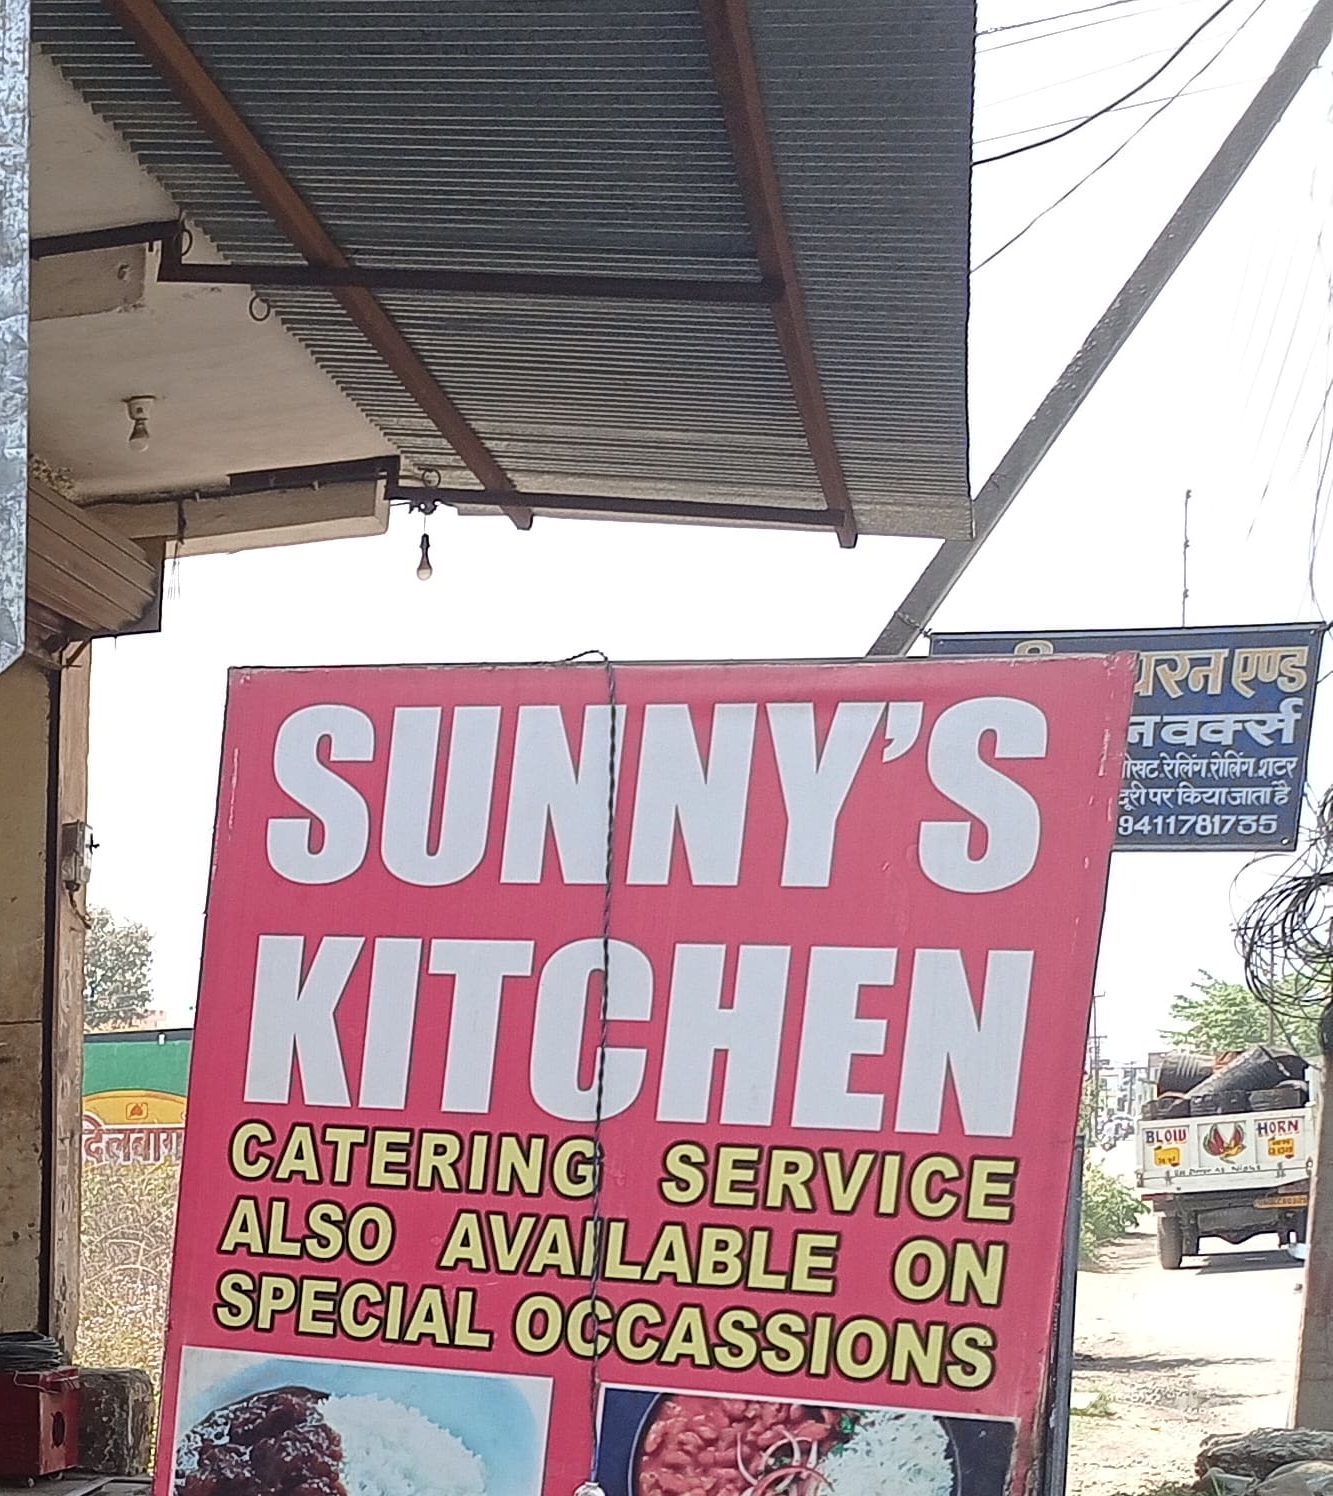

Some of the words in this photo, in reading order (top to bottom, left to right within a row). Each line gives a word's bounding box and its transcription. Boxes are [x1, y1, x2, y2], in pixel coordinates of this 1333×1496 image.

[1231, 646, 1309, 698] एण्ड
[1161, 696, 1304, 747] वर्क्स
[265, 697, 1049, 894] SUNNY'S
[1118, 815, 1278, 836] 9411781735
[1148, 787, 1174, 808] पर
[1272, 780, 1292, 805] है
[243, 934, 1036, 1138] KITCHEN
[1256, 1120, 1299, 1136] HORN
[228, 1121, 604, 1201] CATERING
[659, 1140, 1020, 1223] SERVICE
[220, 1196, 395, 1266] ALSO
[438, 1210, 840, 1296] AVAILABLE
[891, 1240, 1006, 1309] ON
[215, 1270, 493, 1351] SPECIAL
[513, 1292, 998, 1392] OCCASSIONS
